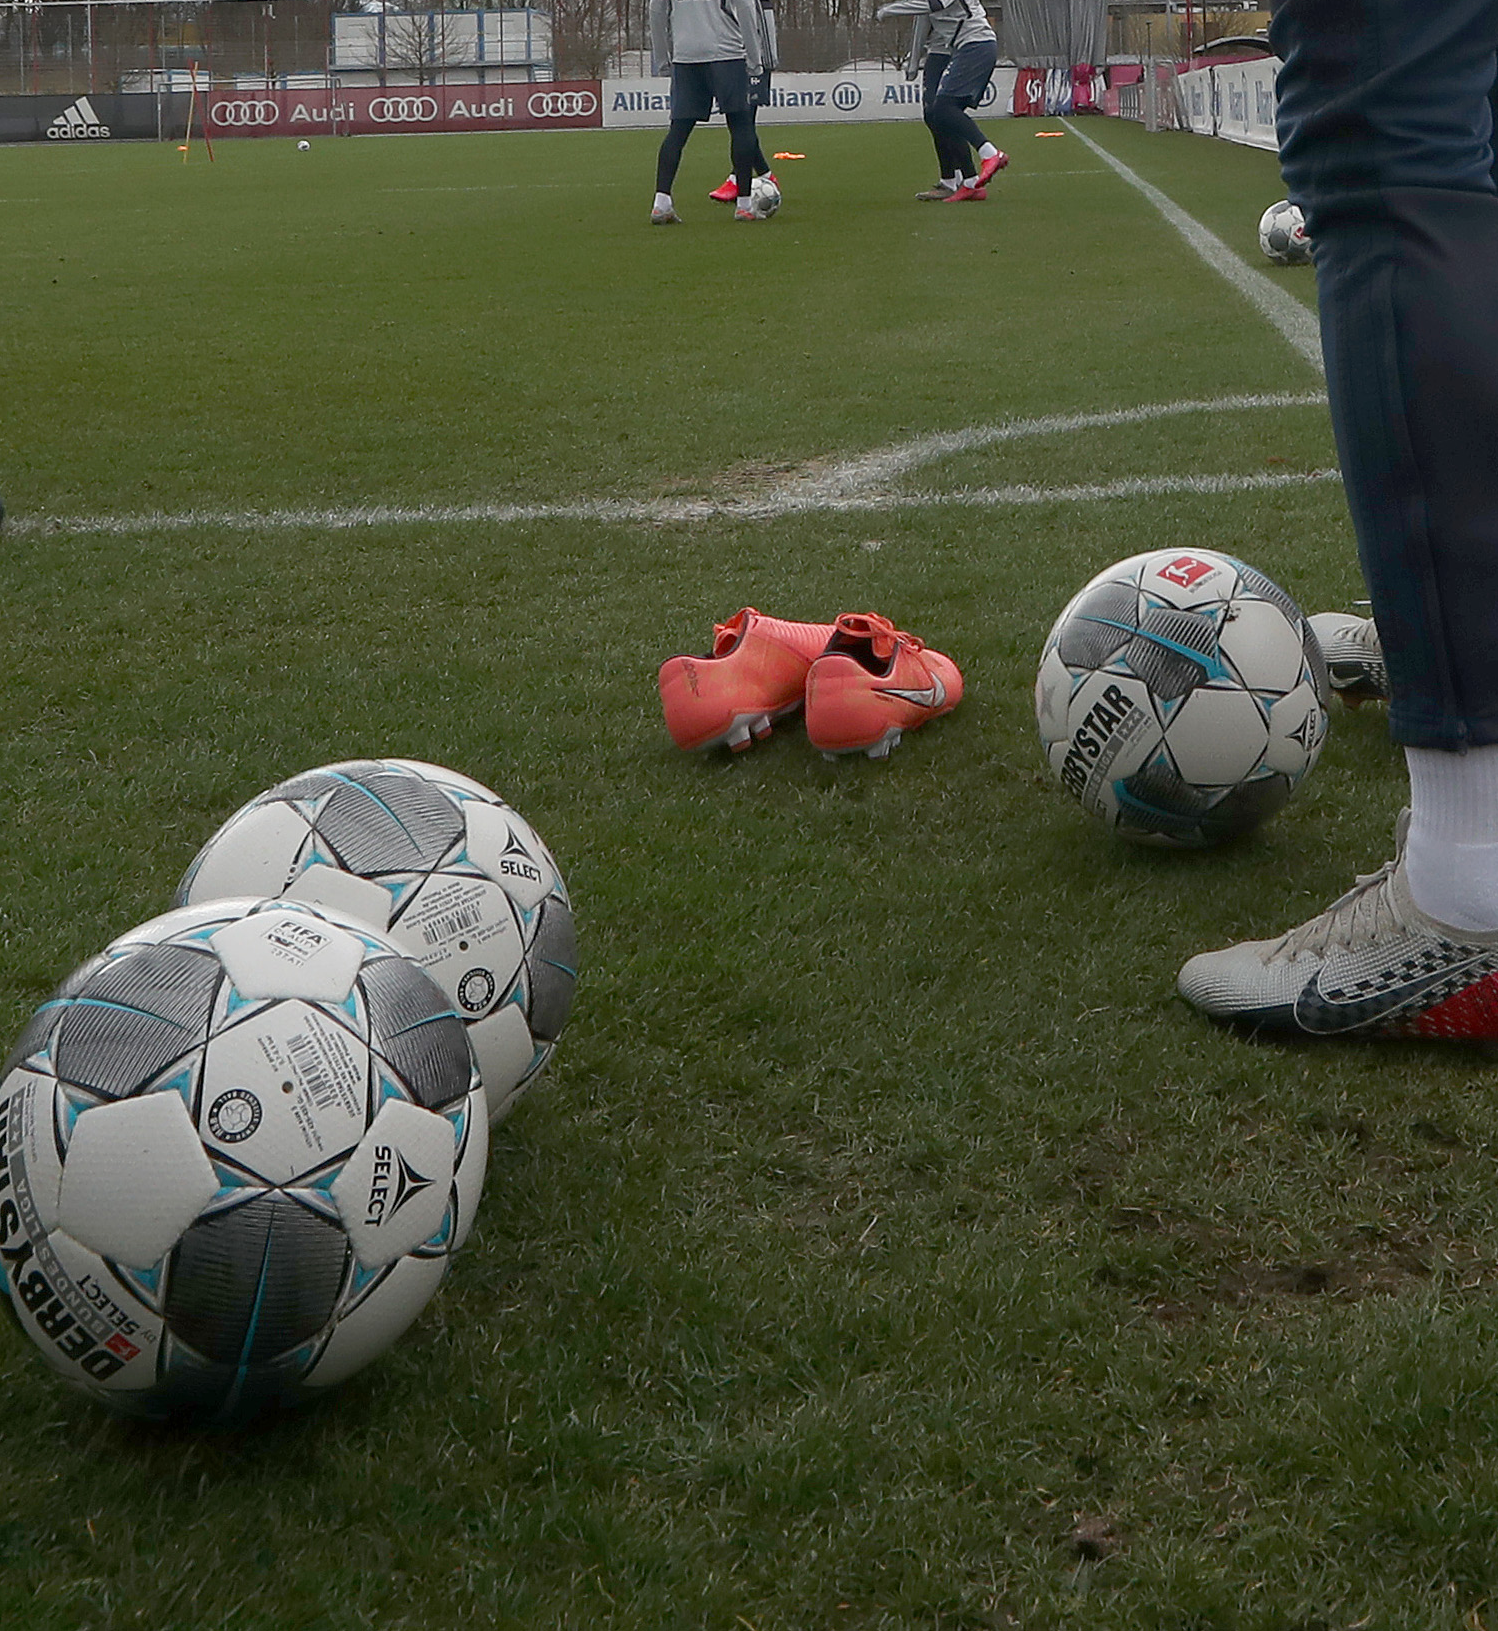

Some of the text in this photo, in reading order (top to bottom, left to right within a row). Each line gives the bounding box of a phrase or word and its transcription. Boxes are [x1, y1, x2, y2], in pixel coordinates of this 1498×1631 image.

[612, 91, 671, 112] Allia
[761, 87, 826, 108] llianz
[882, 83, 921, 105] Alli
[290, 97, 514, 123] Audi Audi
[46, 123, 111, 139] adidas
[500, 860, 542, 885] SELECT
[274, 928, 318, 948] QUALITY
[281, 921, 323, 944] FIFA
[365, 1145, 392, 1228] SELECT
[76, 1273, 142, 1338] SELECT
